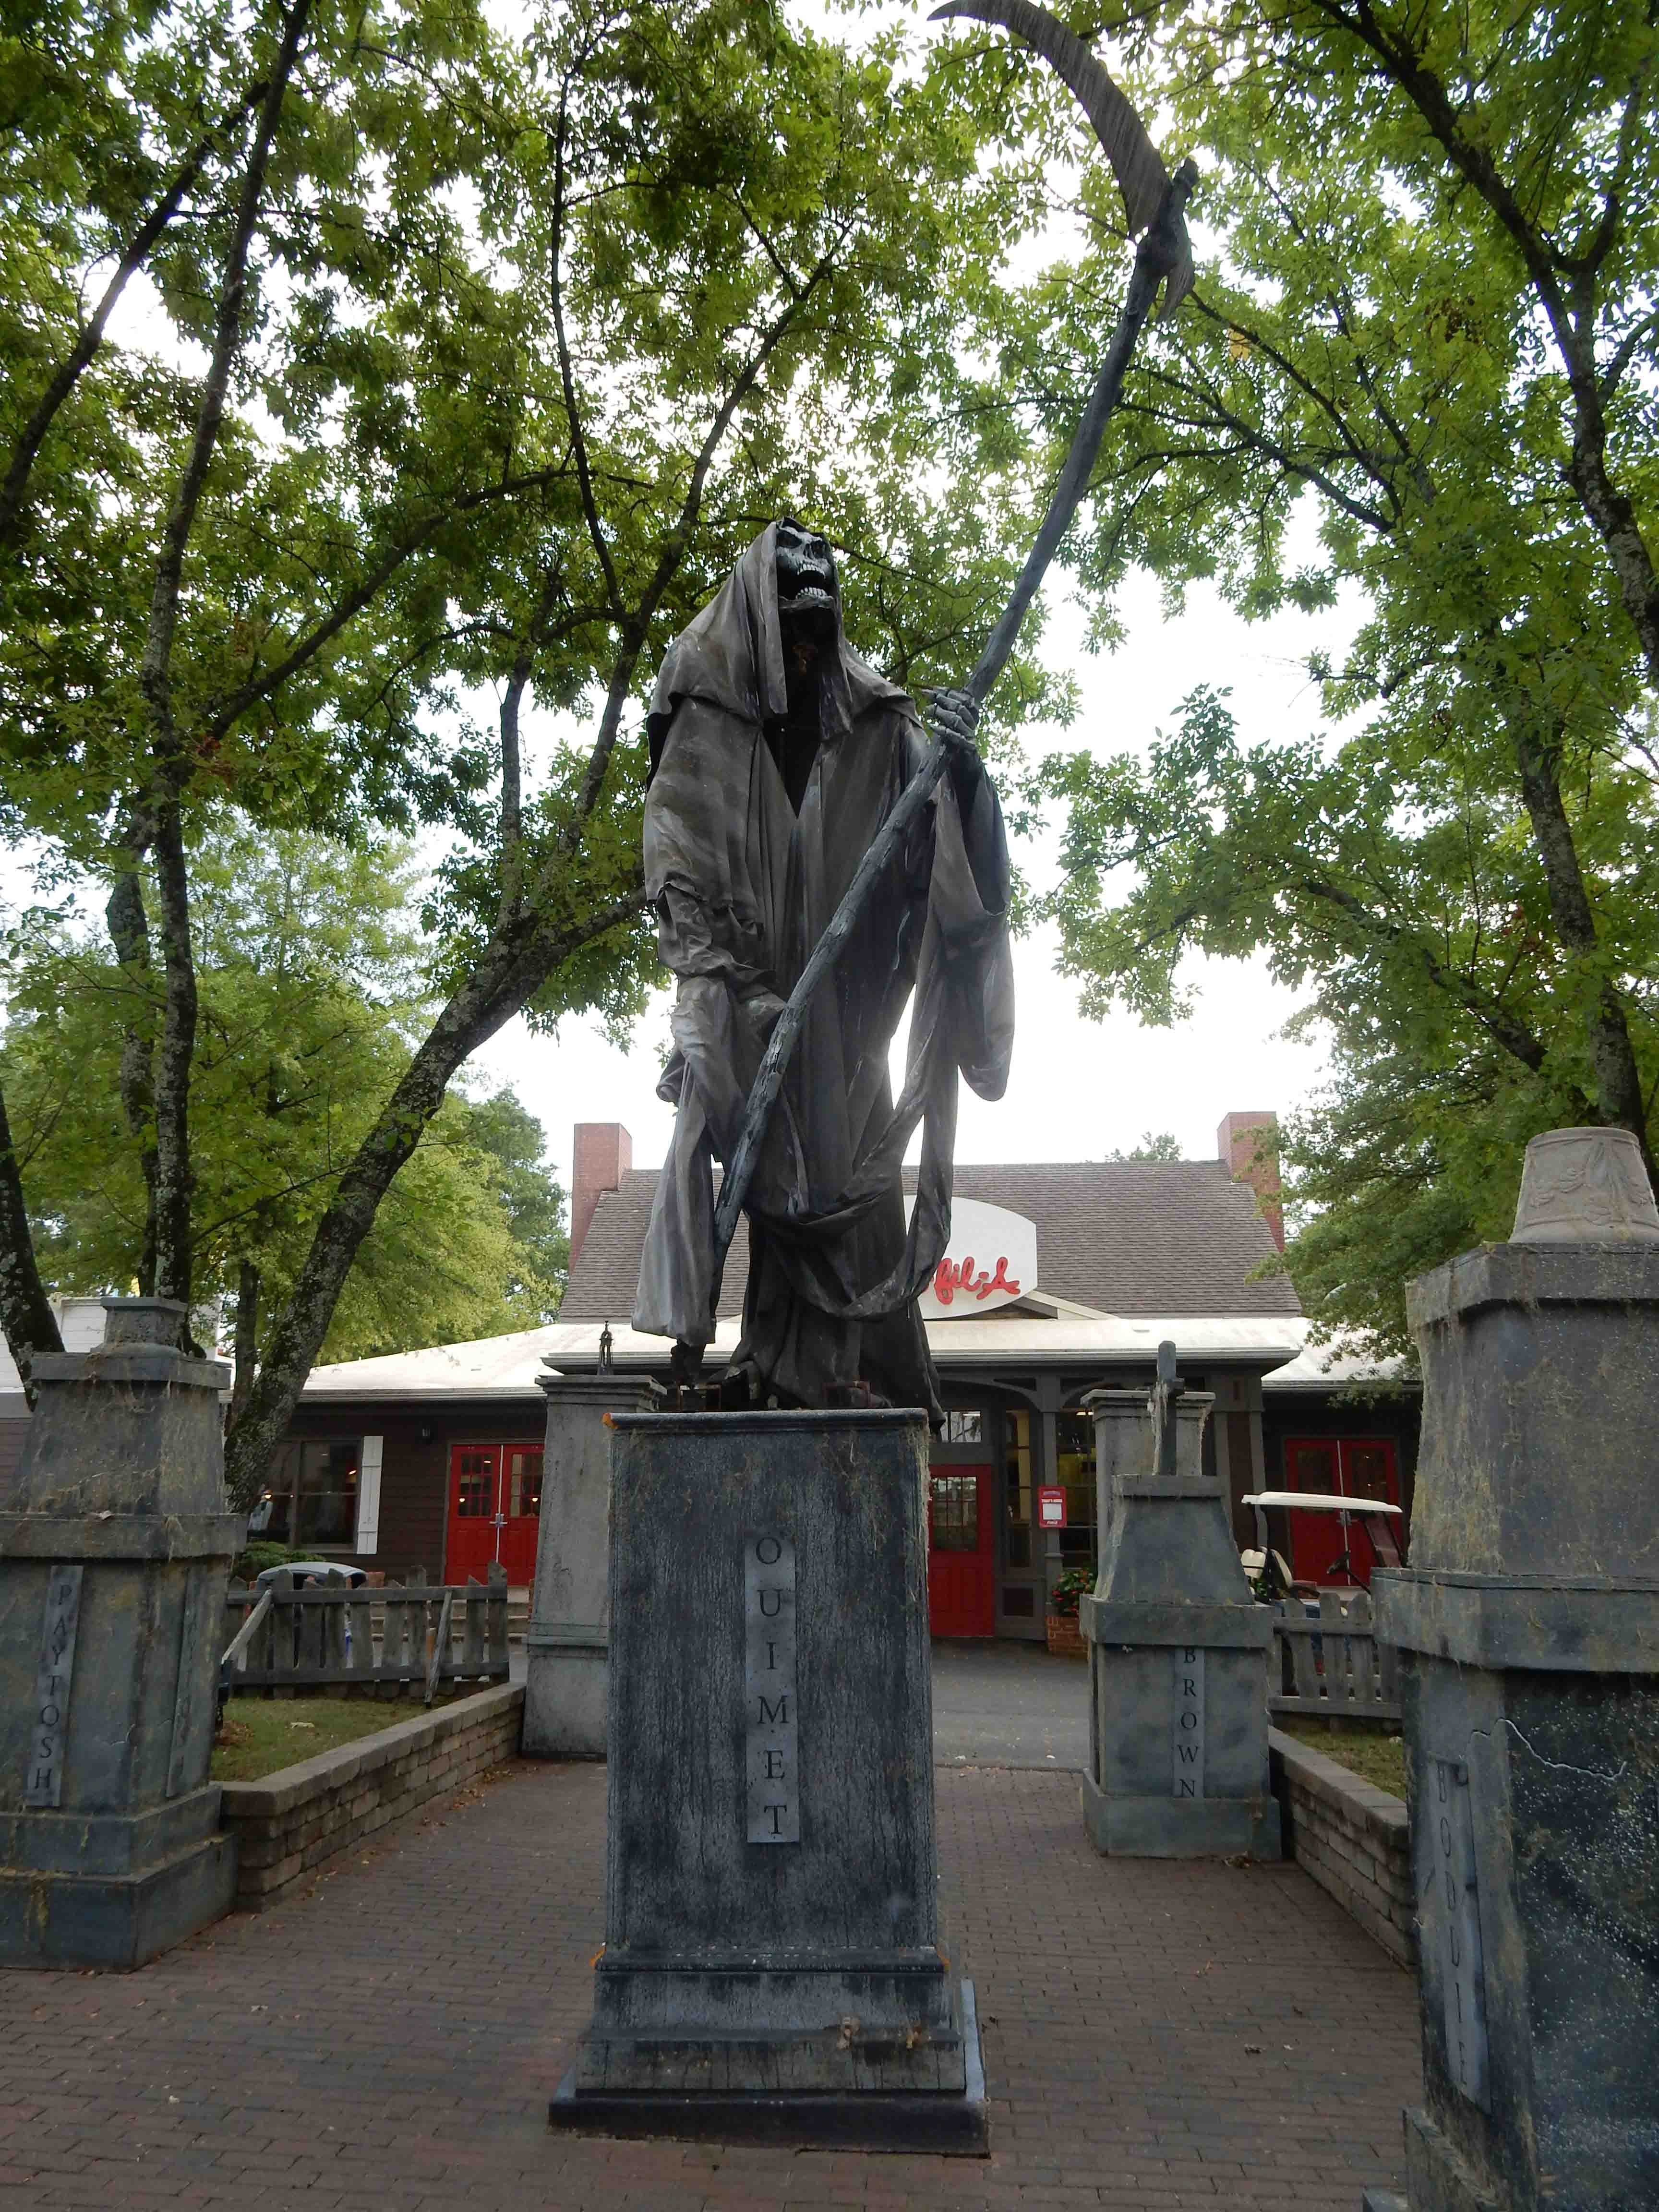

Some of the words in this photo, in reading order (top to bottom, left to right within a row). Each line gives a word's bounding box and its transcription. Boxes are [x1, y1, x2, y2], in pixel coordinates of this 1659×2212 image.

[922, 1256, 1021, 1305] fil-A
[34, 1584, 72, 1790] PAYTOSH
[755, 1537, 789, 1835] OUIMET
[1177, 1647, 1199, 1797] BROWN
